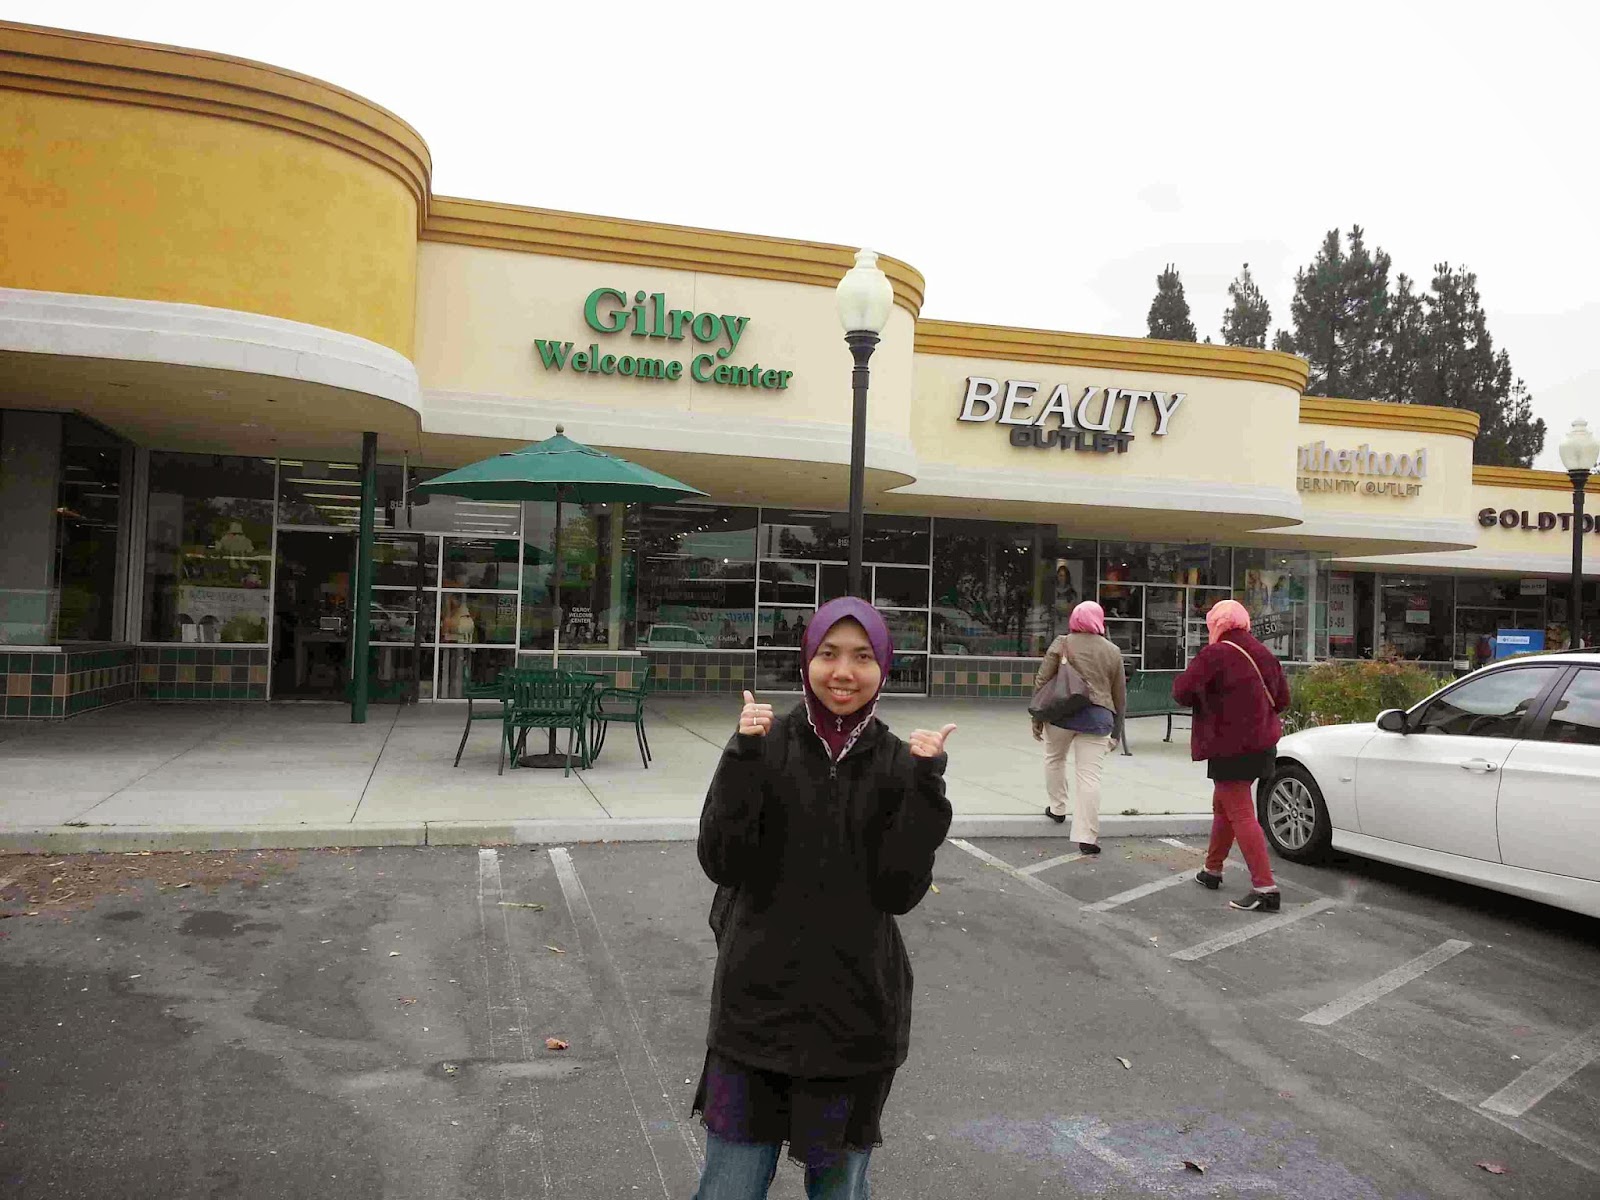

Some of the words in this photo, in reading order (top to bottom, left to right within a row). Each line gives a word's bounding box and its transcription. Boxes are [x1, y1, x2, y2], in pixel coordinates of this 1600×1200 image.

[584, 287, 750, 358] Gilroy
[534, 339, 683, 380] Welcome
[691, 353, 793, 389] Center
[957, 376, 1187, 436] BEAUTY
[1009, 425, 1135, 454] OUTLET
[1365, 481, 1423, 496] OUTLET
